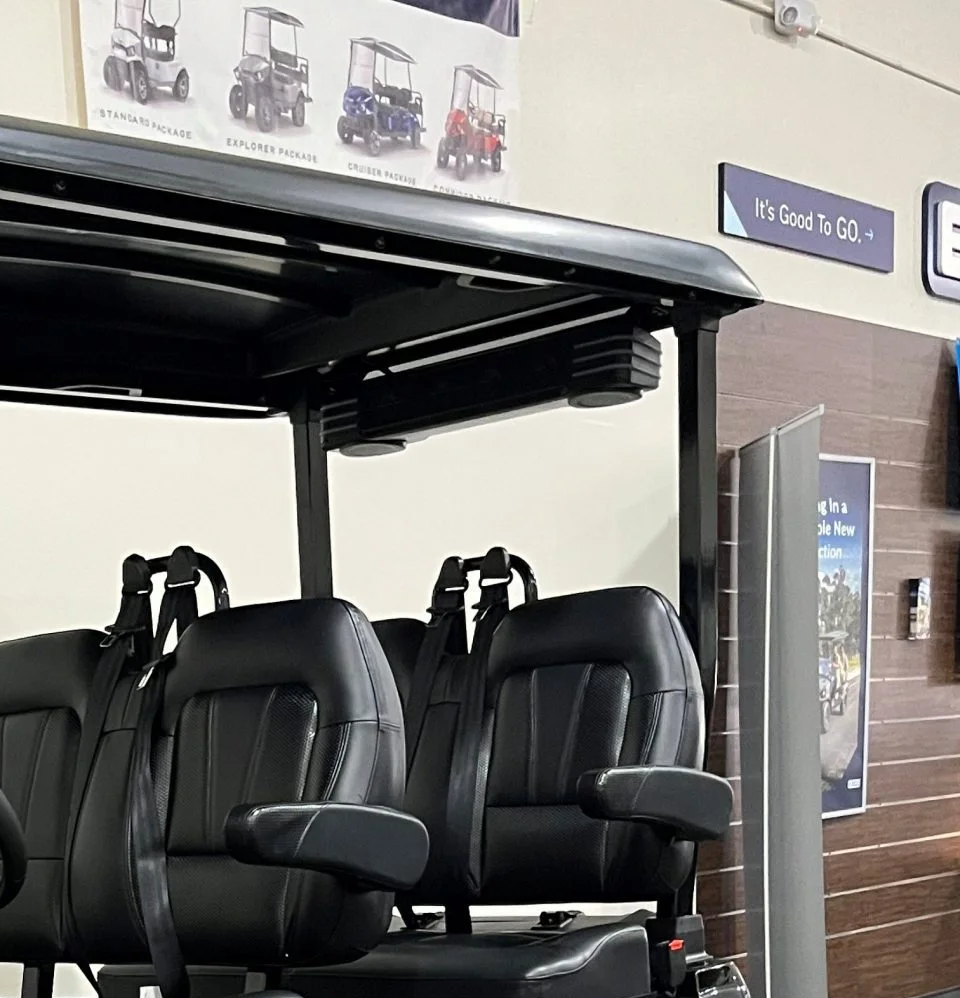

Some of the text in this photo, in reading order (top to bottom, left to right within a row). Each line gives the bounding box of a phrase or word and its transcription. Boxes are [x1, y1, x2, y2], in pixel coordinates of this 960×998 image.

[99, 108, 193, 140] STANDARD PACKAGE
[226, 137, 318, 164] EXPLORER PACKAGE
[347, 162, 416, 186] CRUISER PACKAGE
[755, 197, 862, 244] It's Good To GO.
[833, 520, 856, 537] New
